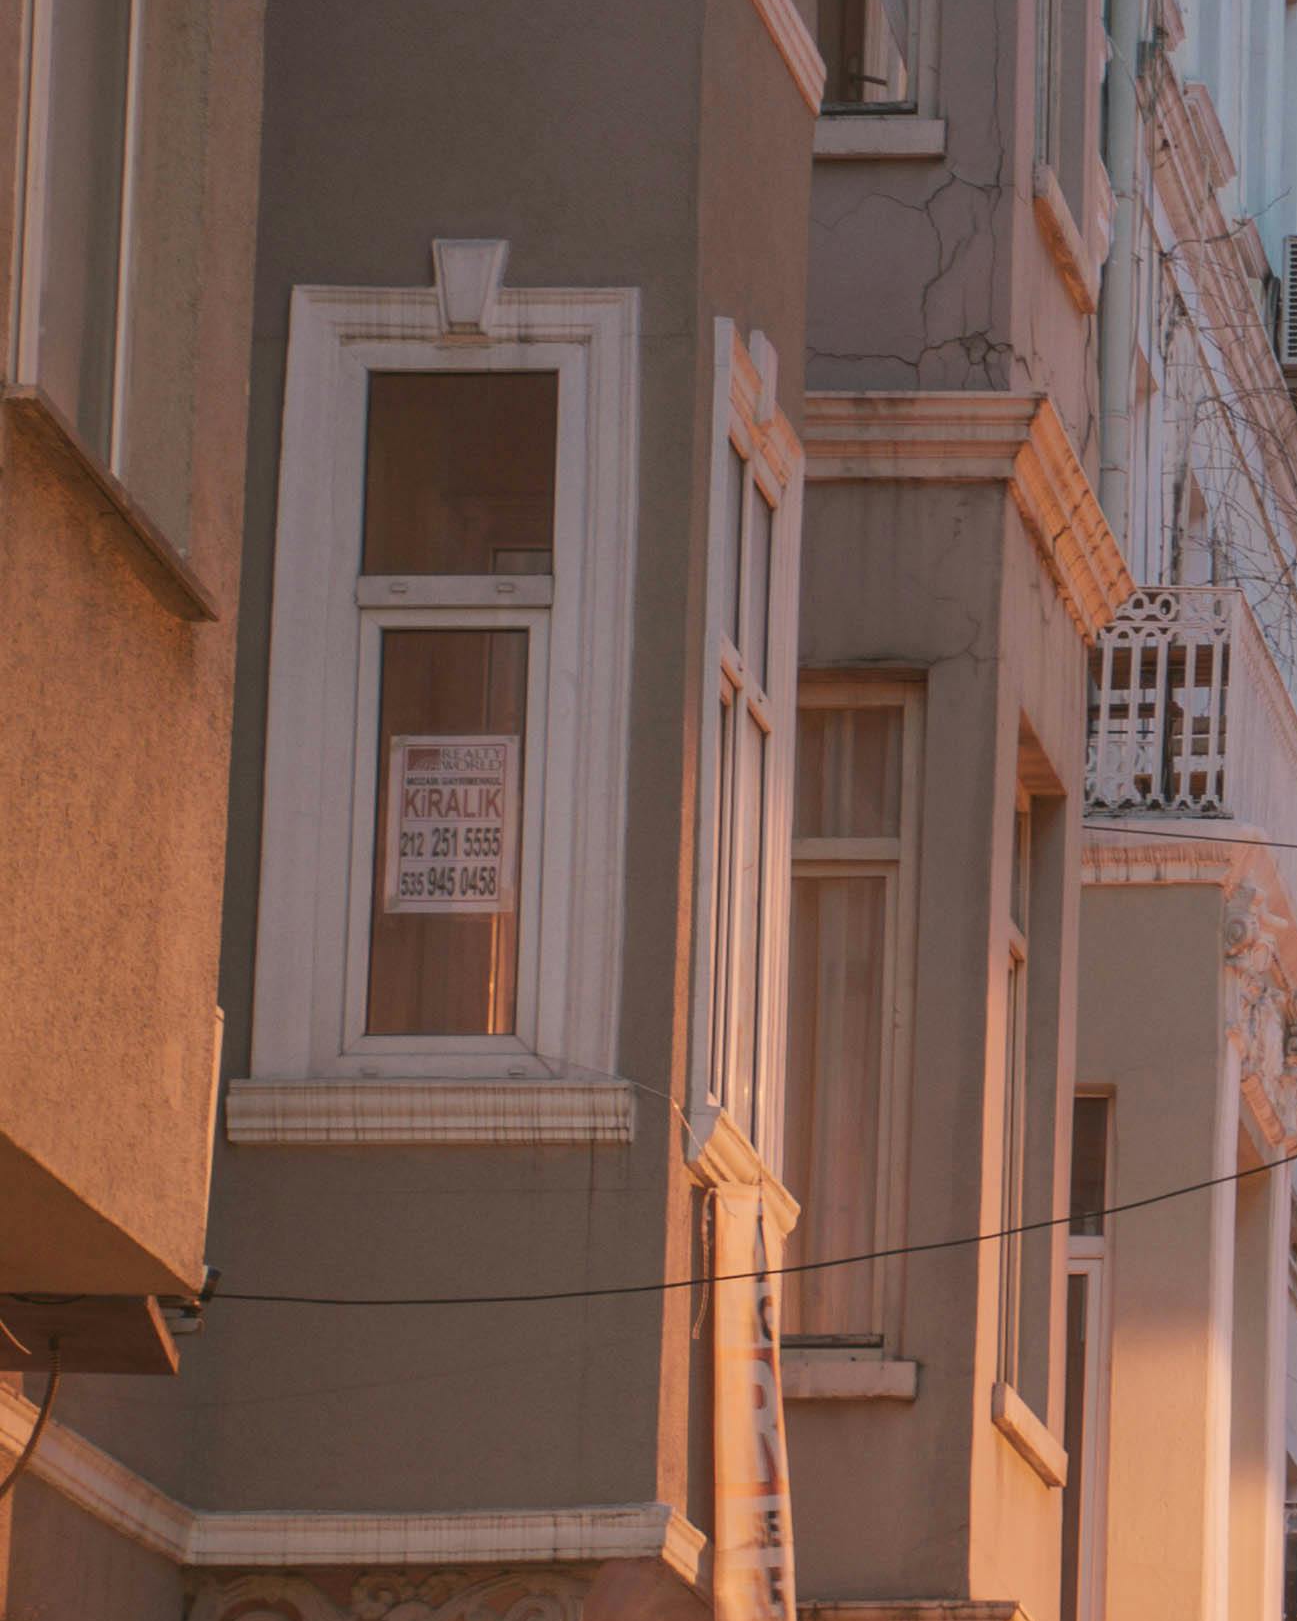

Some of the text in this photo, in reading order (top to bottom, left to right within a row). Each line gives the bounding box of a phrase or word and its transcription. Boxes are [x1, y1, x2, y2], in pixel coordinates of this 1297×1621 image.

[400, 827, 501, 857] 212 251 5555
[427, 867, 455, 896] 945
[460, 867, 497, 896] 0458
